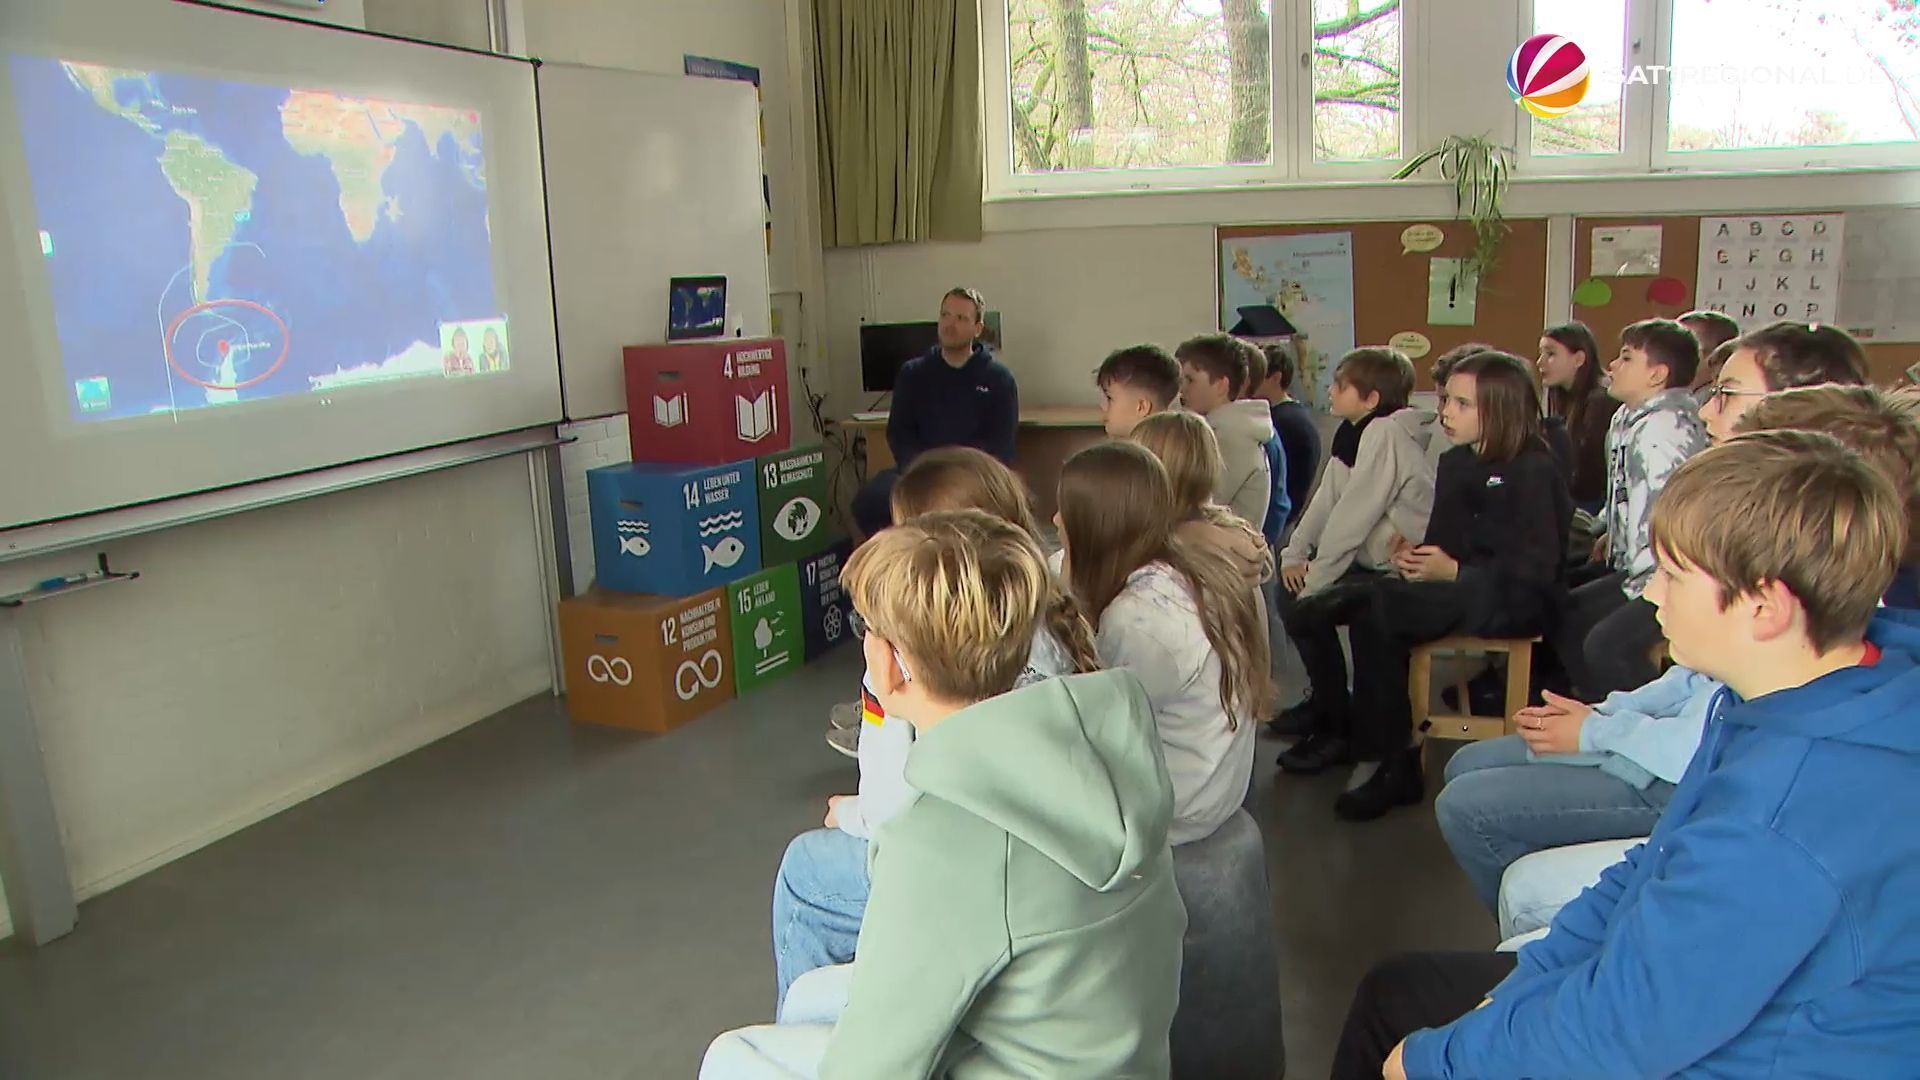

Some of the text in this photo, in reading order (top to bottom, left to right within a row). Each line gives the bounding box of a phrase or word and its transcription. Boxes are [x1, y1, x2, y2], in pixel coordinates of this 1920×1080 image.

[1717, 221, 1826, 237] A B C D
[1749, 249, 1760, 263] F
[1779, 249, 1792, 263] G
[1811, 249, 1824, 262] H
[1718, 275, 1820, 291] I J K L
[1742, 303, 1755, 318] N
[1774, 303, 1788, 317] O
[1807, 303, 1819, 318] P
[723, 352, 734, 380] 4
[763, 462, 778, 490] 13
[683, 480, 700, 511] 14
[704, 487, 730, 505] WASSER
[806, 560, 817, 587] 17
[737, 587, 752, 614] 15
[661, 616, 678, 647] 12
